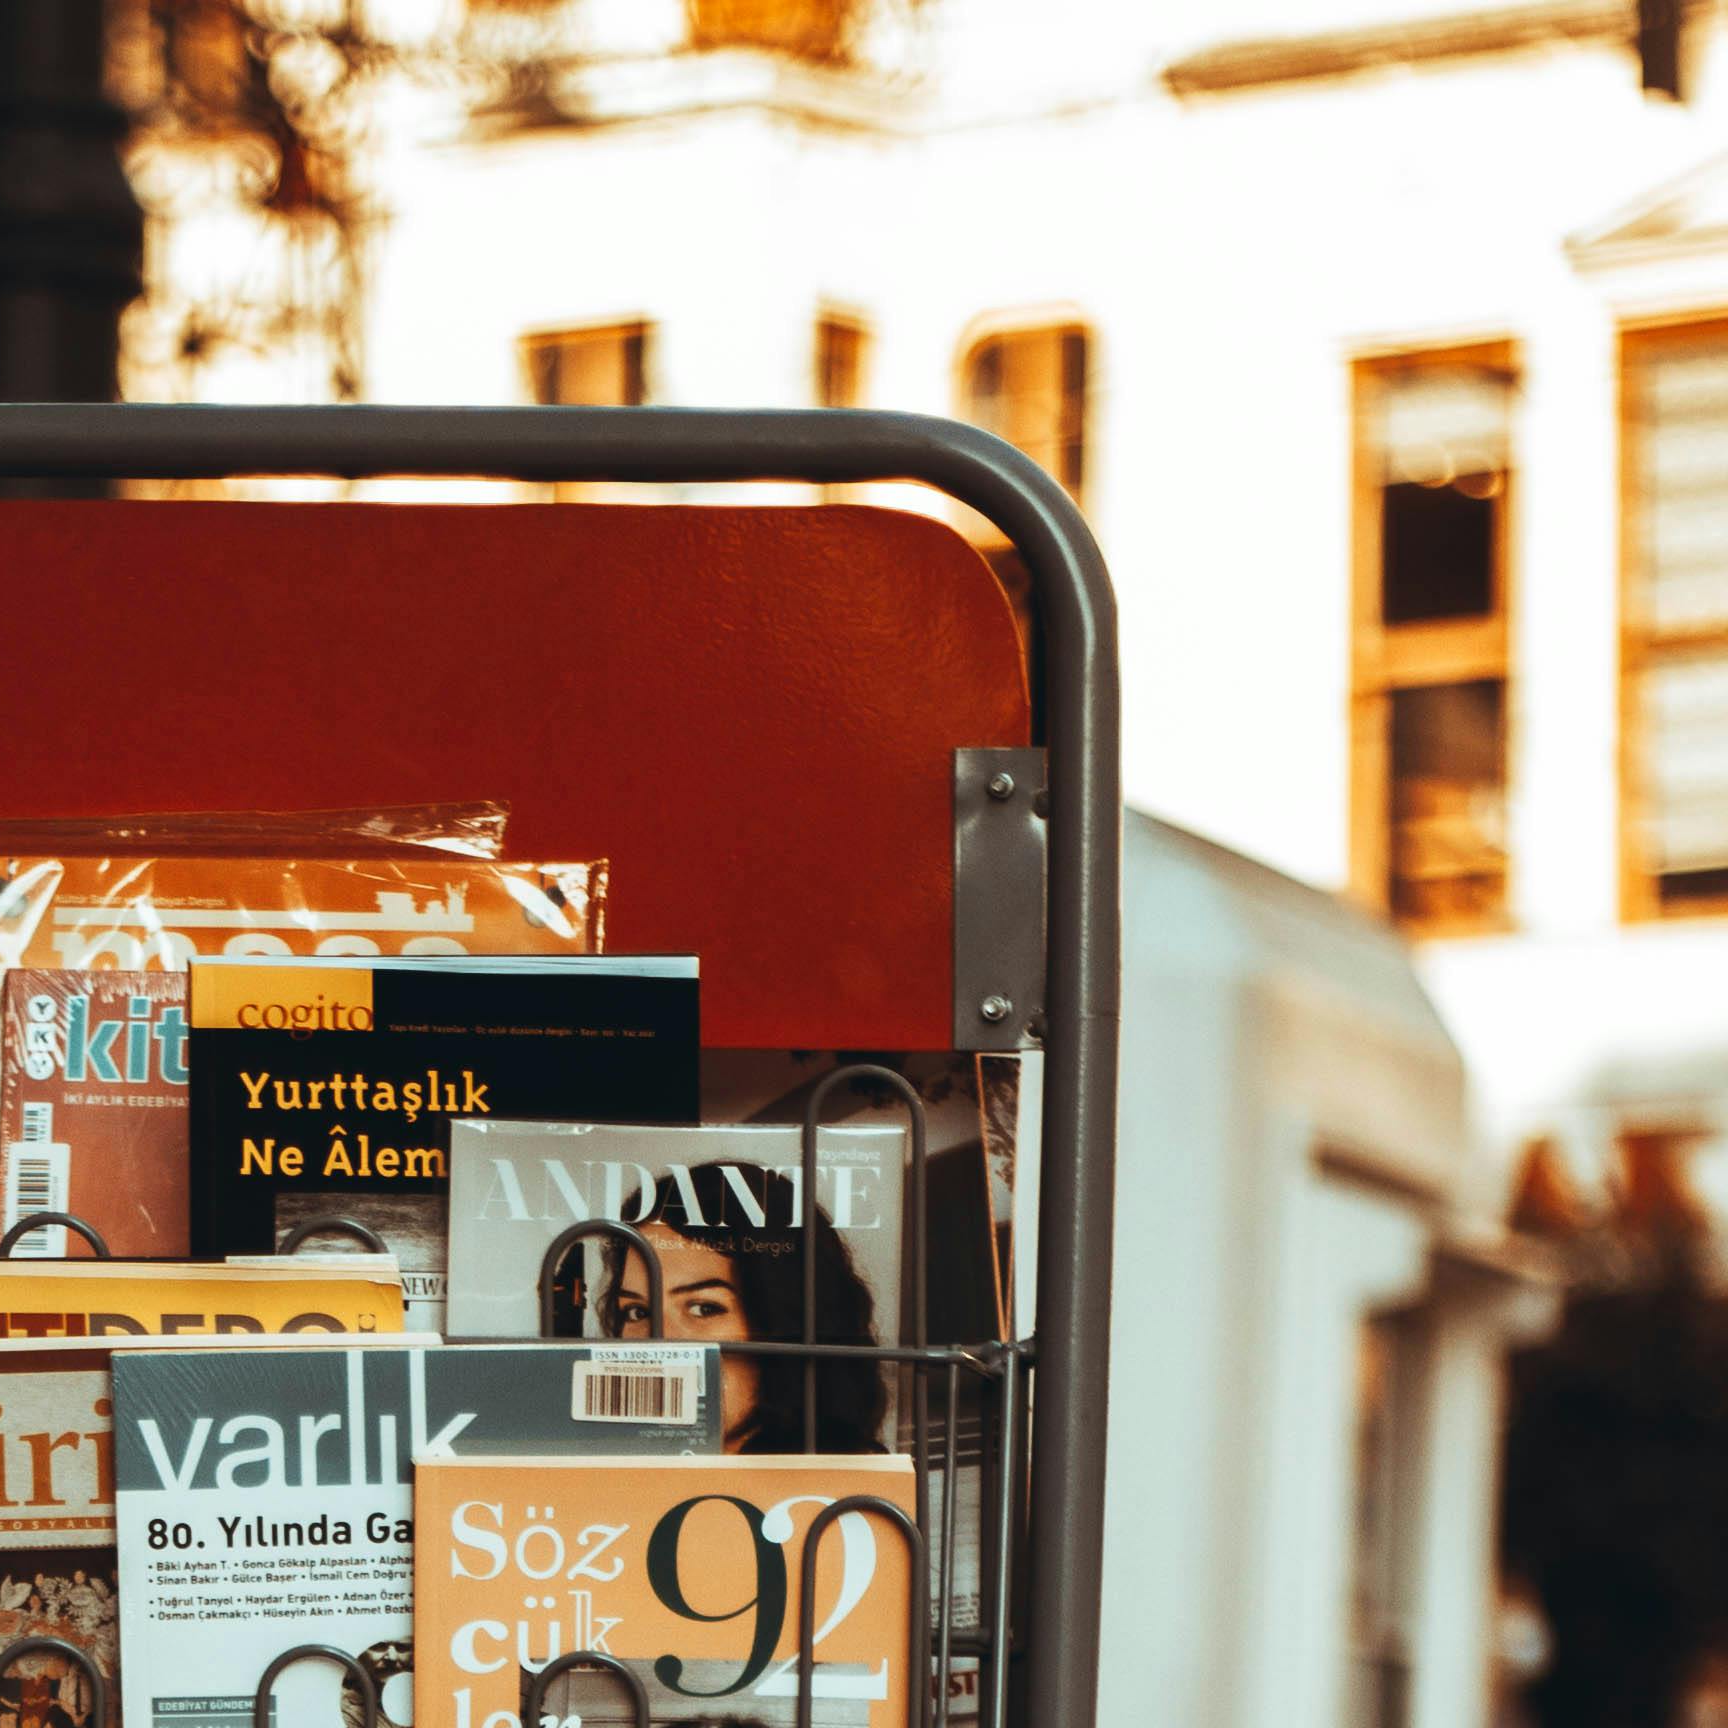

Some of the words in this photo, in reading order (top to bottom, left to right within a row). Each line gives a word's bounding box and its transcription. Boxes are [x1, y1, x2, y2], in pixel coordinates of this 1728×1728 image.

[237, 993, 373, 1040] cogito
[239, 1071, 491, 1122] Yurttaşlık
[238, 1138, 305, 1177] Ne
[323, 1125, 449, 1178] Âlem
[475, 1158, 881, 1229] ANDANTE
[135, 1349, 478, 1491] varlık
[148, 1518, 206, 1550] 80.
[218, 1514, 352, 1549] Yılında
[156, 1573, 187, 1586] Sinan
[190, 1573, 220, 1585] Bakır
[231, 1572, 263, 1584] Gülce
[266, 1571, 298, 1585] Başer
[346, 1569, 370, 1580] Cem
[373, 1568, 407, 1581] Doğru
[184, 1560, 218, 1574] Ayhan
[242, 1558, 275, 1570] Gonca
[278, 1557, 316, 1571] Gökalp
[158, 1595, 194, 1609] Tuğrul
[197, 1594, 233, 1608] Tanyol
[245, 1593, 284, 1607] Haydar
[343, 1590, 377, 1602] Adnan
[158, 1609, 195, 1621] Osman
[262, 1606, 307, 1620] Hüseyin
[346, 1605, 382, 1616] Ahmet
[450, 1501, 630, 1582] Söz
[646, 1494, 889, 1700] 92
[450, 1589, 624, 1675] cük
